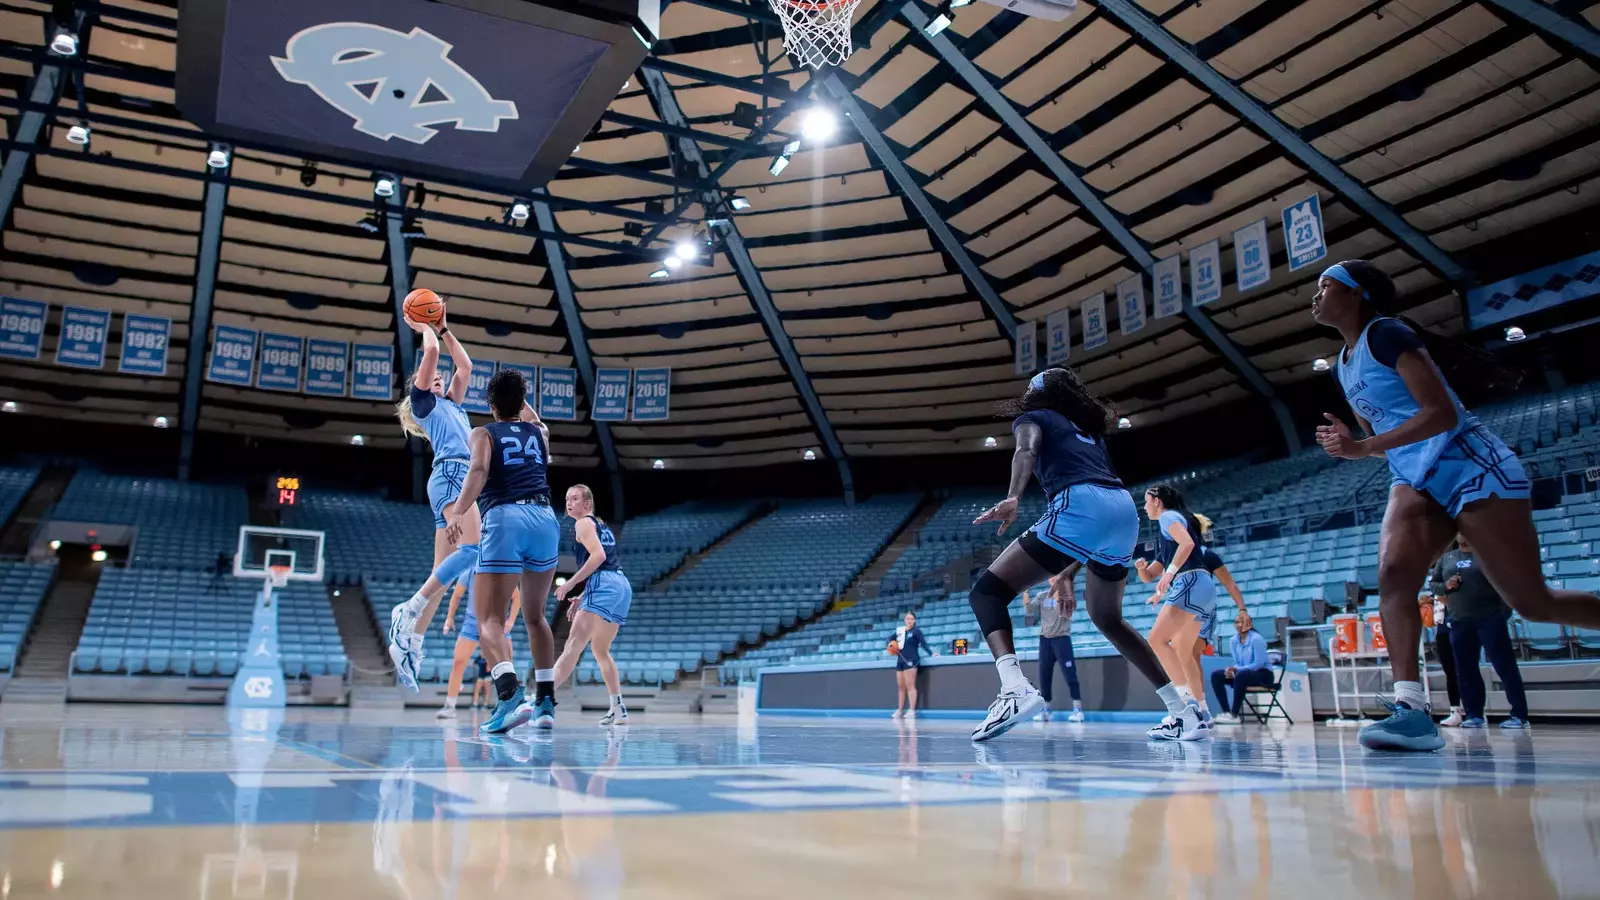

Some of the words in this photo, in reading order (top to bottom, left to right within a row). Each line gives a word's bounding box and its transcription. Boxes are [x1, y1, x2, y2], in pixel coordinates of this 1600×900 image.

[1296, 223, 1313, 243] 23
[1244, 246, 1260, 266] 00
[1298, 249, 1318, 264] SMITH
[1198, 264, 1213, 283] 34
[1161, 280, 1174, 297] 20
[0, 314, 42, 335] 1980
[66, 322, 103, 344] 1981
[127, 330, 166, 350] 1982
[216, 341, 252, 361] 1983
[263, 349, 299, 368] 1988
[310, 354, 345, 373] 1989
[355, 359, 390, 376] 1999
[542, 382, 574, 398] 2008
[598, 384, 627, 399] 2014
[636, 382, 667, 398] 2016
[500, 435, 543, 466] 24
[279, 489, 295, 505] 14
